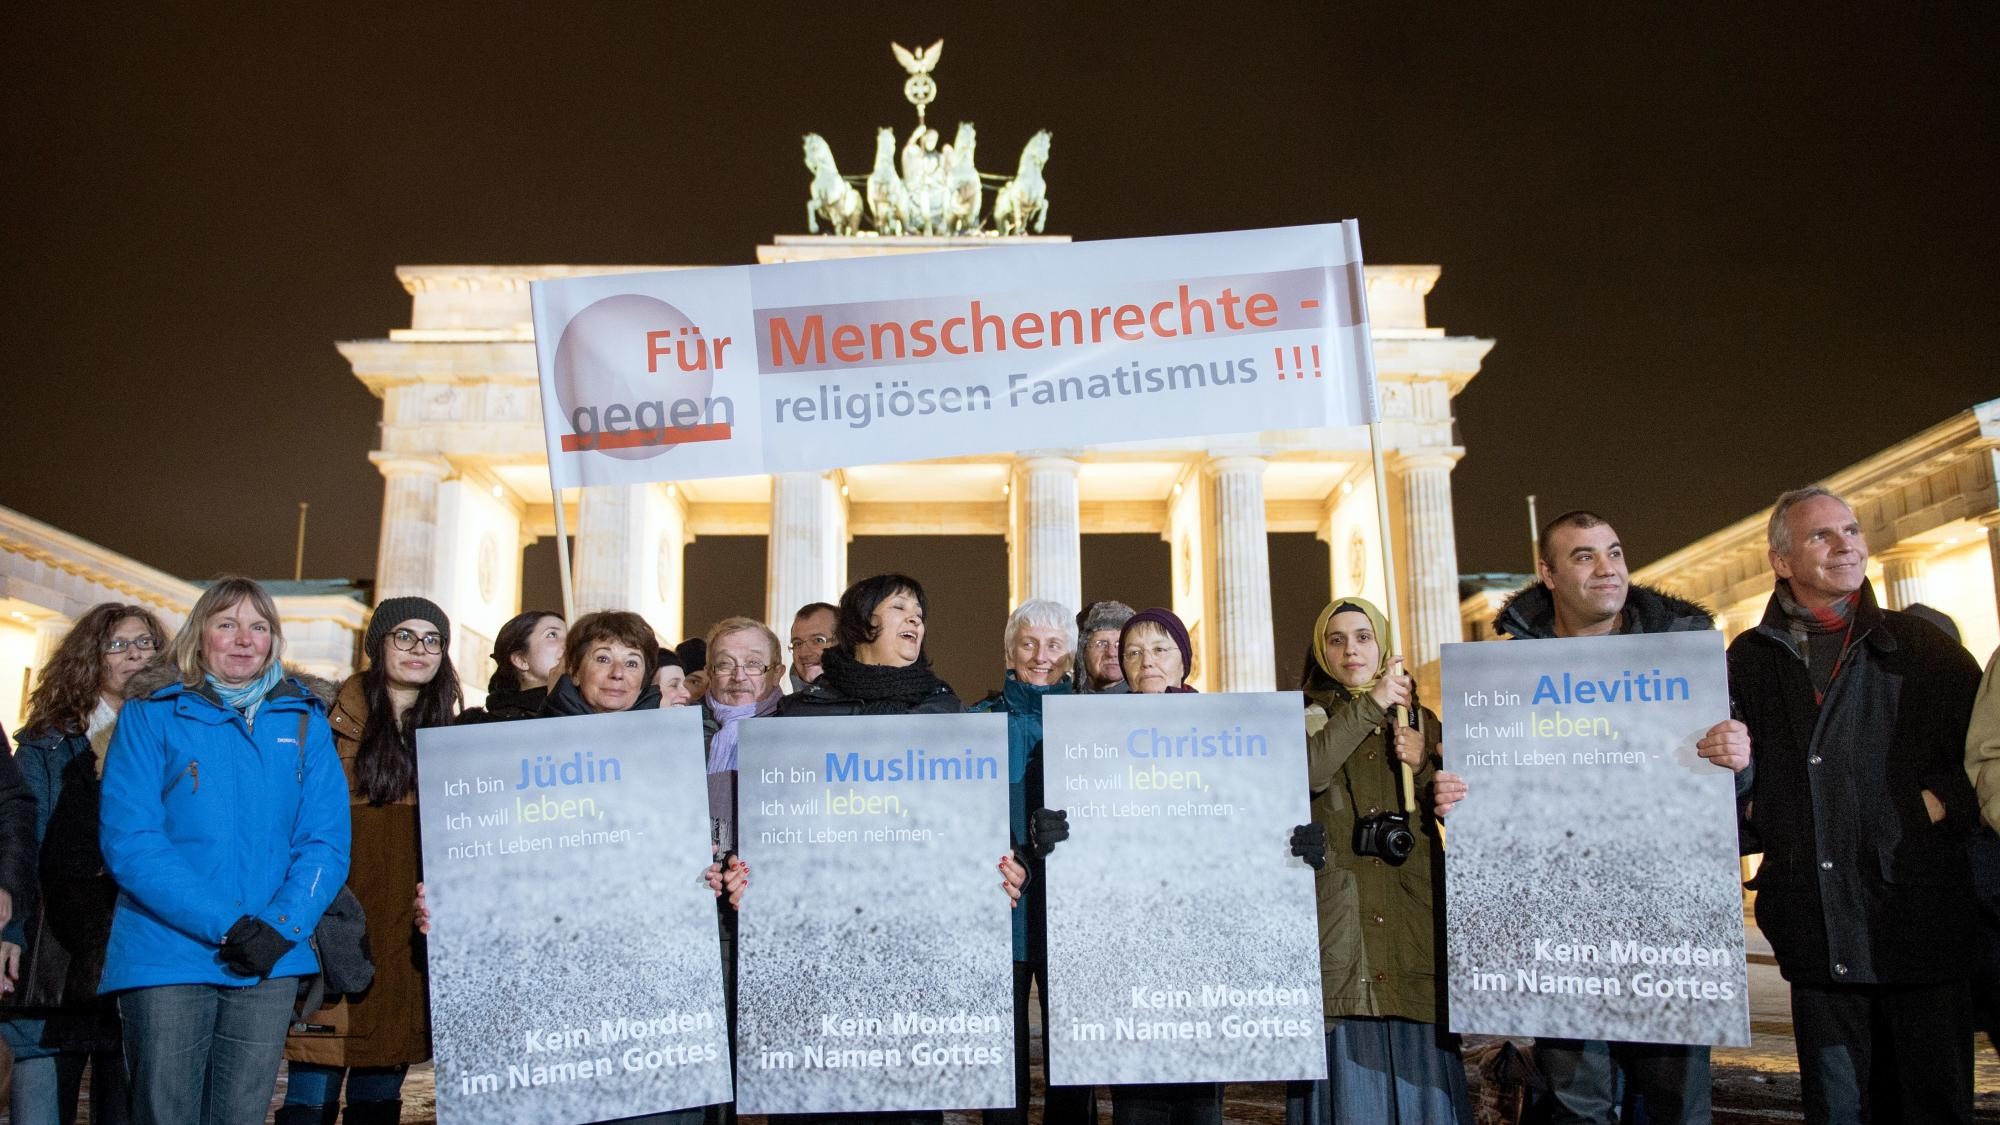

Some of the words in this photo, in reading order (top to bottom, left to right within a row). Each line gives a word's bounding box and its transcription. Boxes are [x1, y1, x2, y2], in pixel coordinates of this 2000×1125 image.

[769, 286, 1279, 367] Menschenrechte
[646, 327, 731, 373] Für
[775, 381, 991, 429] religiösen
[1008, 357, 1258, 408] Fanatismus
[1274, 345, 1322, 381] !!!
[572, 396, 735, 451] gegen
[1464, 692, 1488, 707] Ich
[1494, 691, 1520, 706] bin
[1532, 669, 1689, 705] Alevitin
[1466, 723, 1489, 739] Ich
[1494, 722, 1523, 738] will
[1532, 711, 1619, 740] leben,
[1065, 744, 1088, 760] Ich
[1094, 744, 1119, 759] bin
[1127, 727, 1267, 759] Christin
[1467, 750, 1508, 766] nicht
[1515, 750, 1566, 766] Leben
[1573, 749, 1646, 765] nehmen
[444, 778, 470, 797] Ich
[477, 777, 504, 794] bin
[516, 752, 622, 790] Jüdin
[761, 769, 784, 784] Ich
[790, 768, 816, 783] bin
[826, 749, 998, 783] Muslimin
[1066, 776, 1088, 791] Ich
[1094, 775, 1122, 791] will
[1129, 764, 1210, 793] leben,
[447, 812, 472, 831] Ich
[478, 808, 508, 827] will
[516, 795, 603, 824] leben,
[761, 801, 784, 816] Ich
[790, 800, 818, 815] will
[826, 789, 909, 817] leben,
[1067, 800, 1107, 817] nicht
[1113, 801, 1161, 817] Leben
[1168, 800, 1233, 816] nehmen
[448, 841, 493, 860] nicht
[500, 835, 552, 855] Leben
[560, 827, 631, 849] nehmen
[761, 828, 802, 844] nicht
[808, 827, 858, 844] Leben
[864, 825, 932, 842] nehmen
[1534, 938, 1598, 963] Kein
[1610, 940, 1730, 967] Morden
[1131, 985, 1192, 1009] Kein
[1202, 983, 1308, 1008] Morden
[1473, 967, 1507, 991] im
[1517, 969, 1621, 996] Namen
[1632, 973, 1735, 1001] Gottes
[526, 1024, 591, 1053] Kein
[600, 1010, 713, 1043] Morden
[822, 1013, 882, 1037] Kein
[893, 1010, 1000, 1035] Morden
[1072, 1017, 1105, 1041] im
[1116, 1017, 1212, 1041] Namen
[1221, 1015, 1313, 1039] Gottes
[462, 1070, 498, 1095] im
[509, 1056, 612, 1089] Namen
[623, 1042, 718, 1072] Gottes
[761, 1046, 794, 1070] im
[804, 1045, 901, 1069] Namen
[911, 1043, 1003, 1066] Gottes
